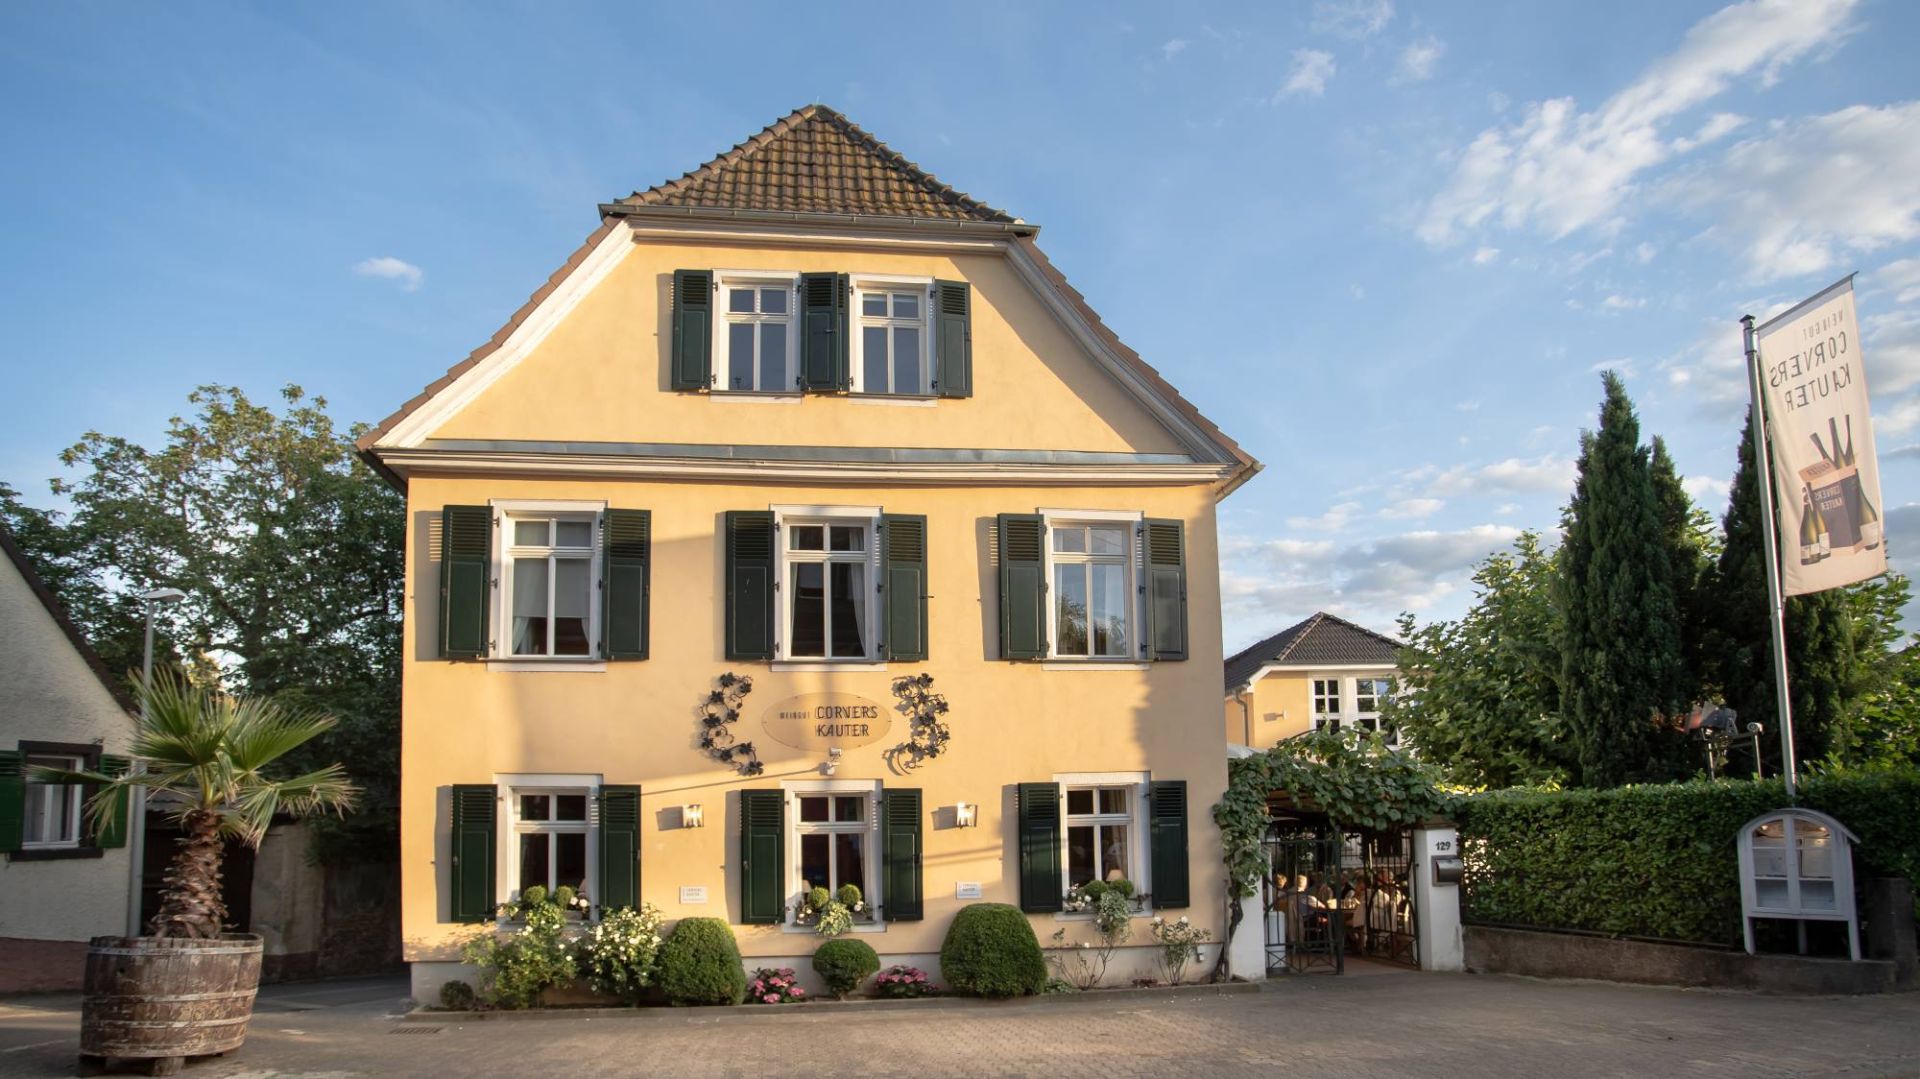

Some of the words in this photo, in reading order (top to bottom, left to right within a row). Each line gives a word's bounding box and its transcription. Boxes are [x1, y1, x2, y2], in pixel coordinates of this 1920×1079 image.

[816, 705, 878, 719] CORVERS
[816, 724, 870, 737] KAUTER
[1436, 841, 1451, 851] 129
